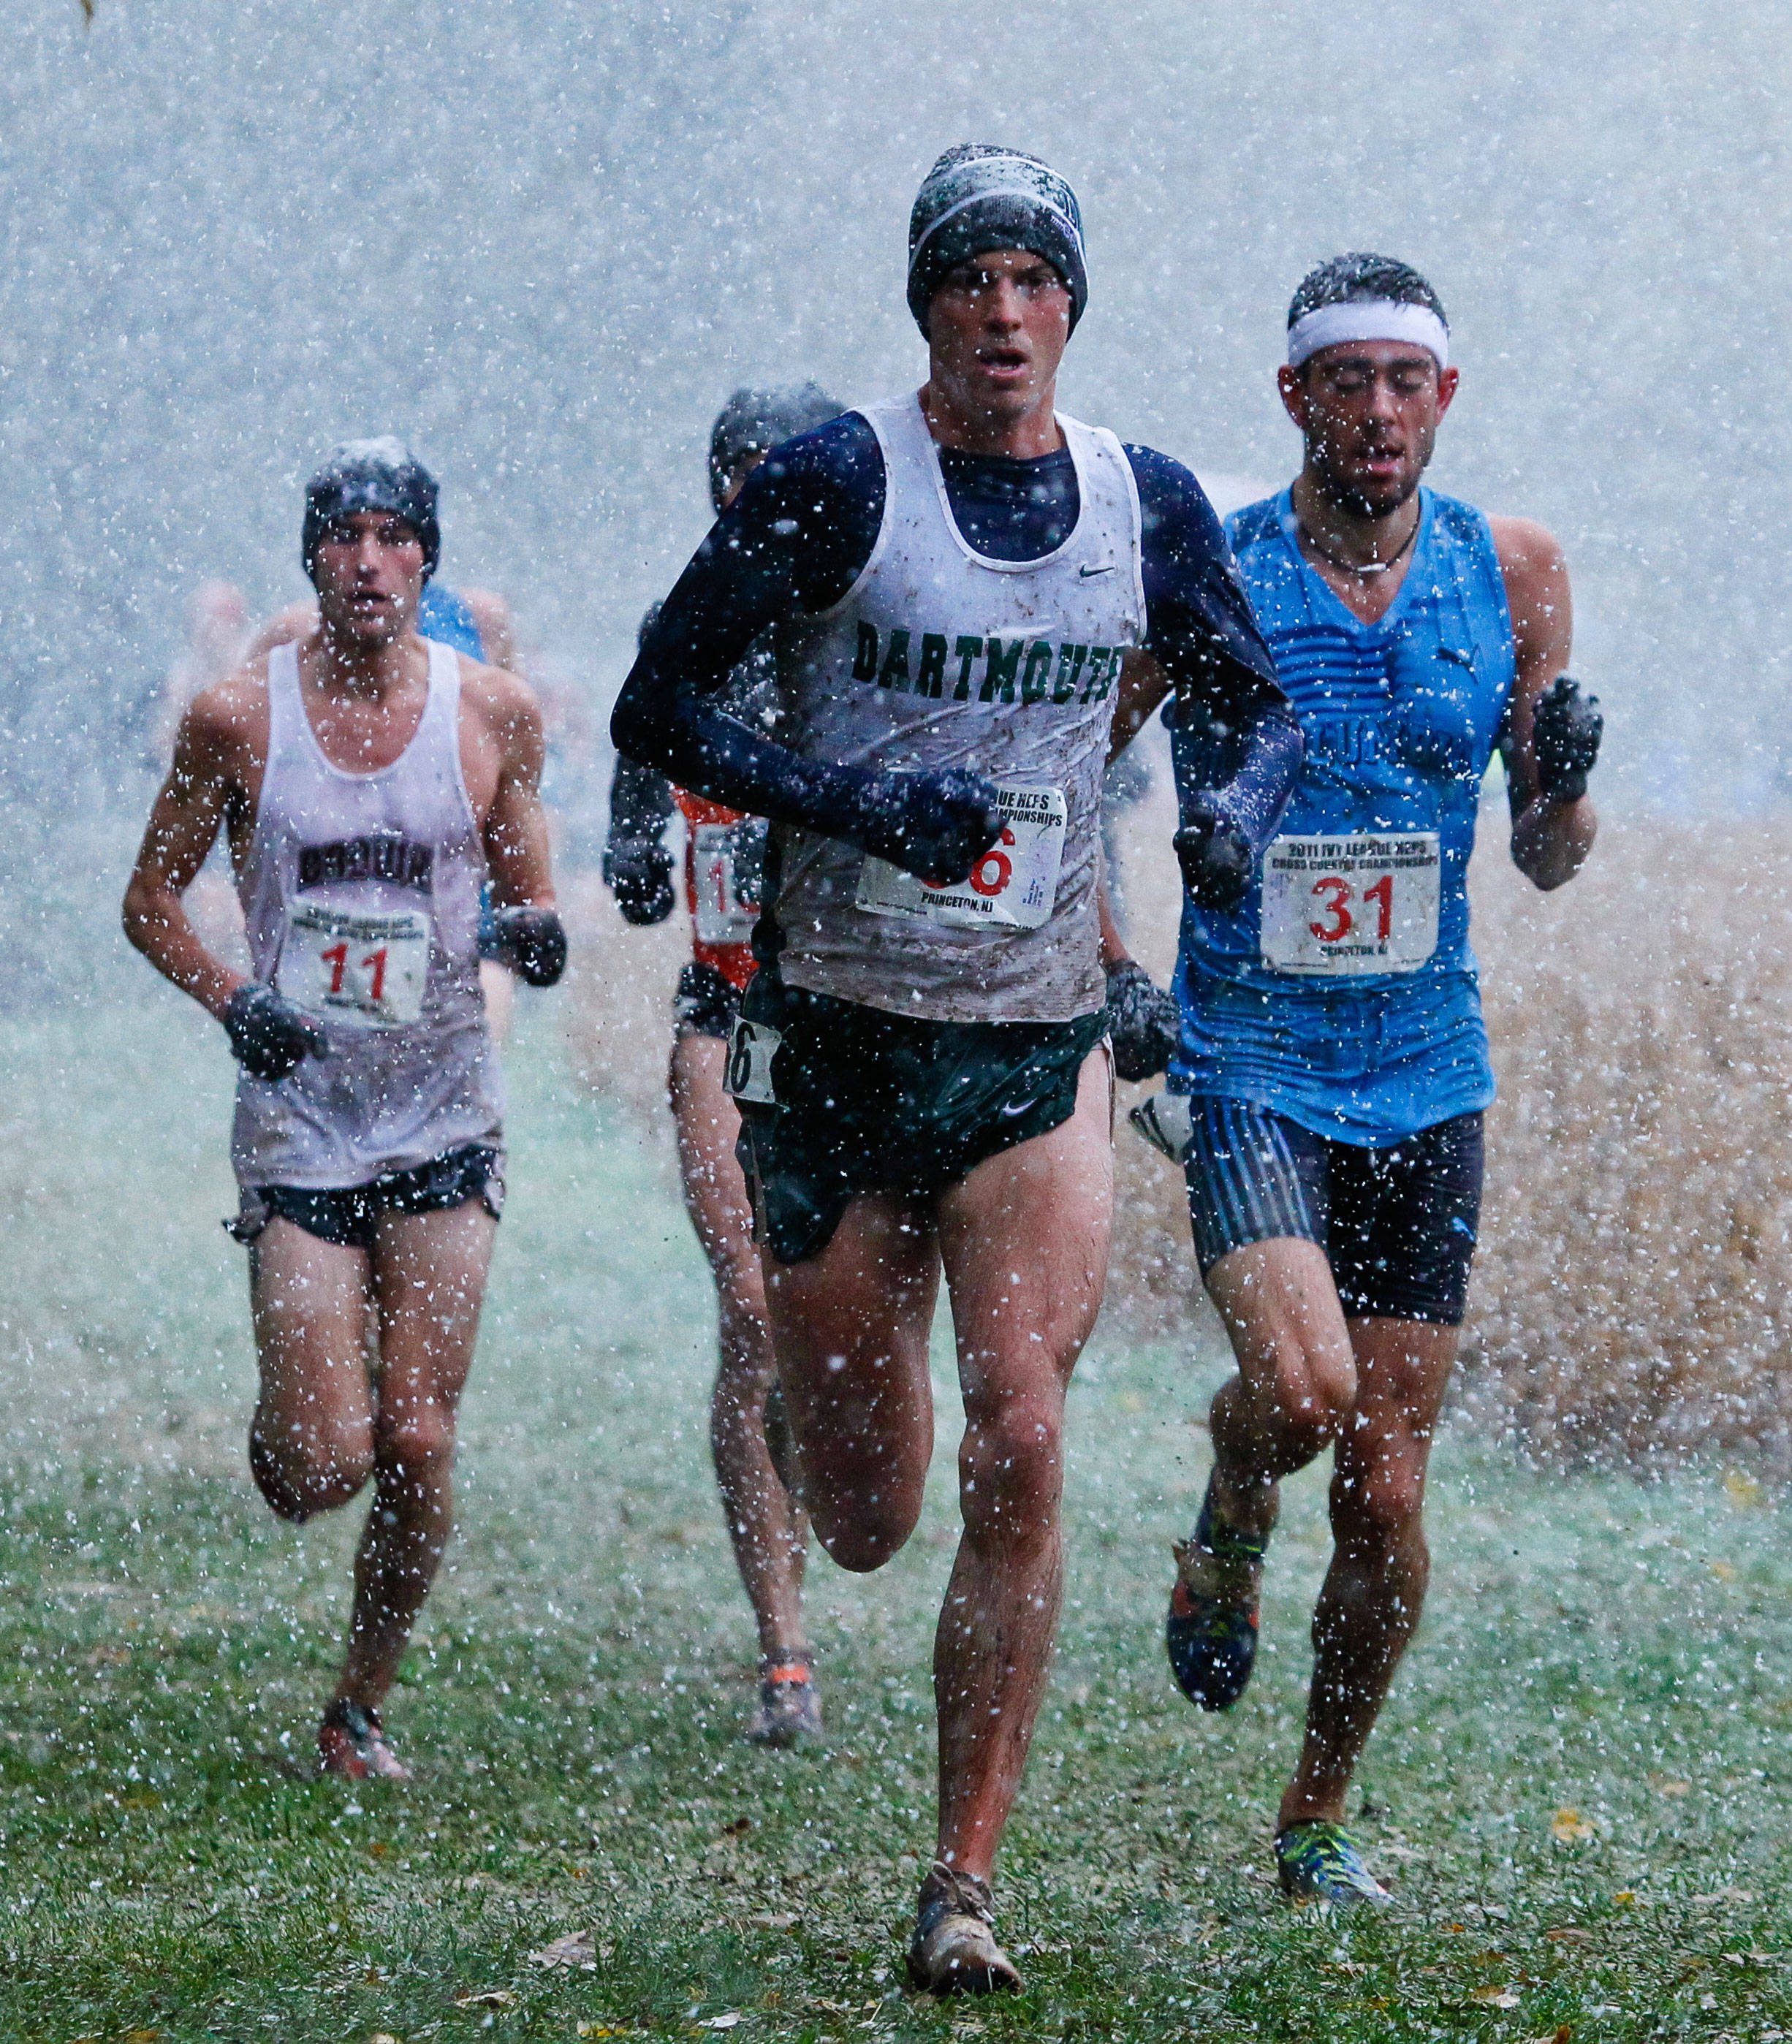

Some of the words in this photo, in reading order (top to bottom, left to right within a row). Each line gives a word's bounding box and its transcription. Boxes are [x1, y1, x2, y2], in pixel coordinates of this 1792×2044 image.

[1288, 843, 1318, 857] 2011
[981, 900, 994, 913] NJ
[1309, 875, 1394, 942] 31
[321, 943, 388, 1000] 11
